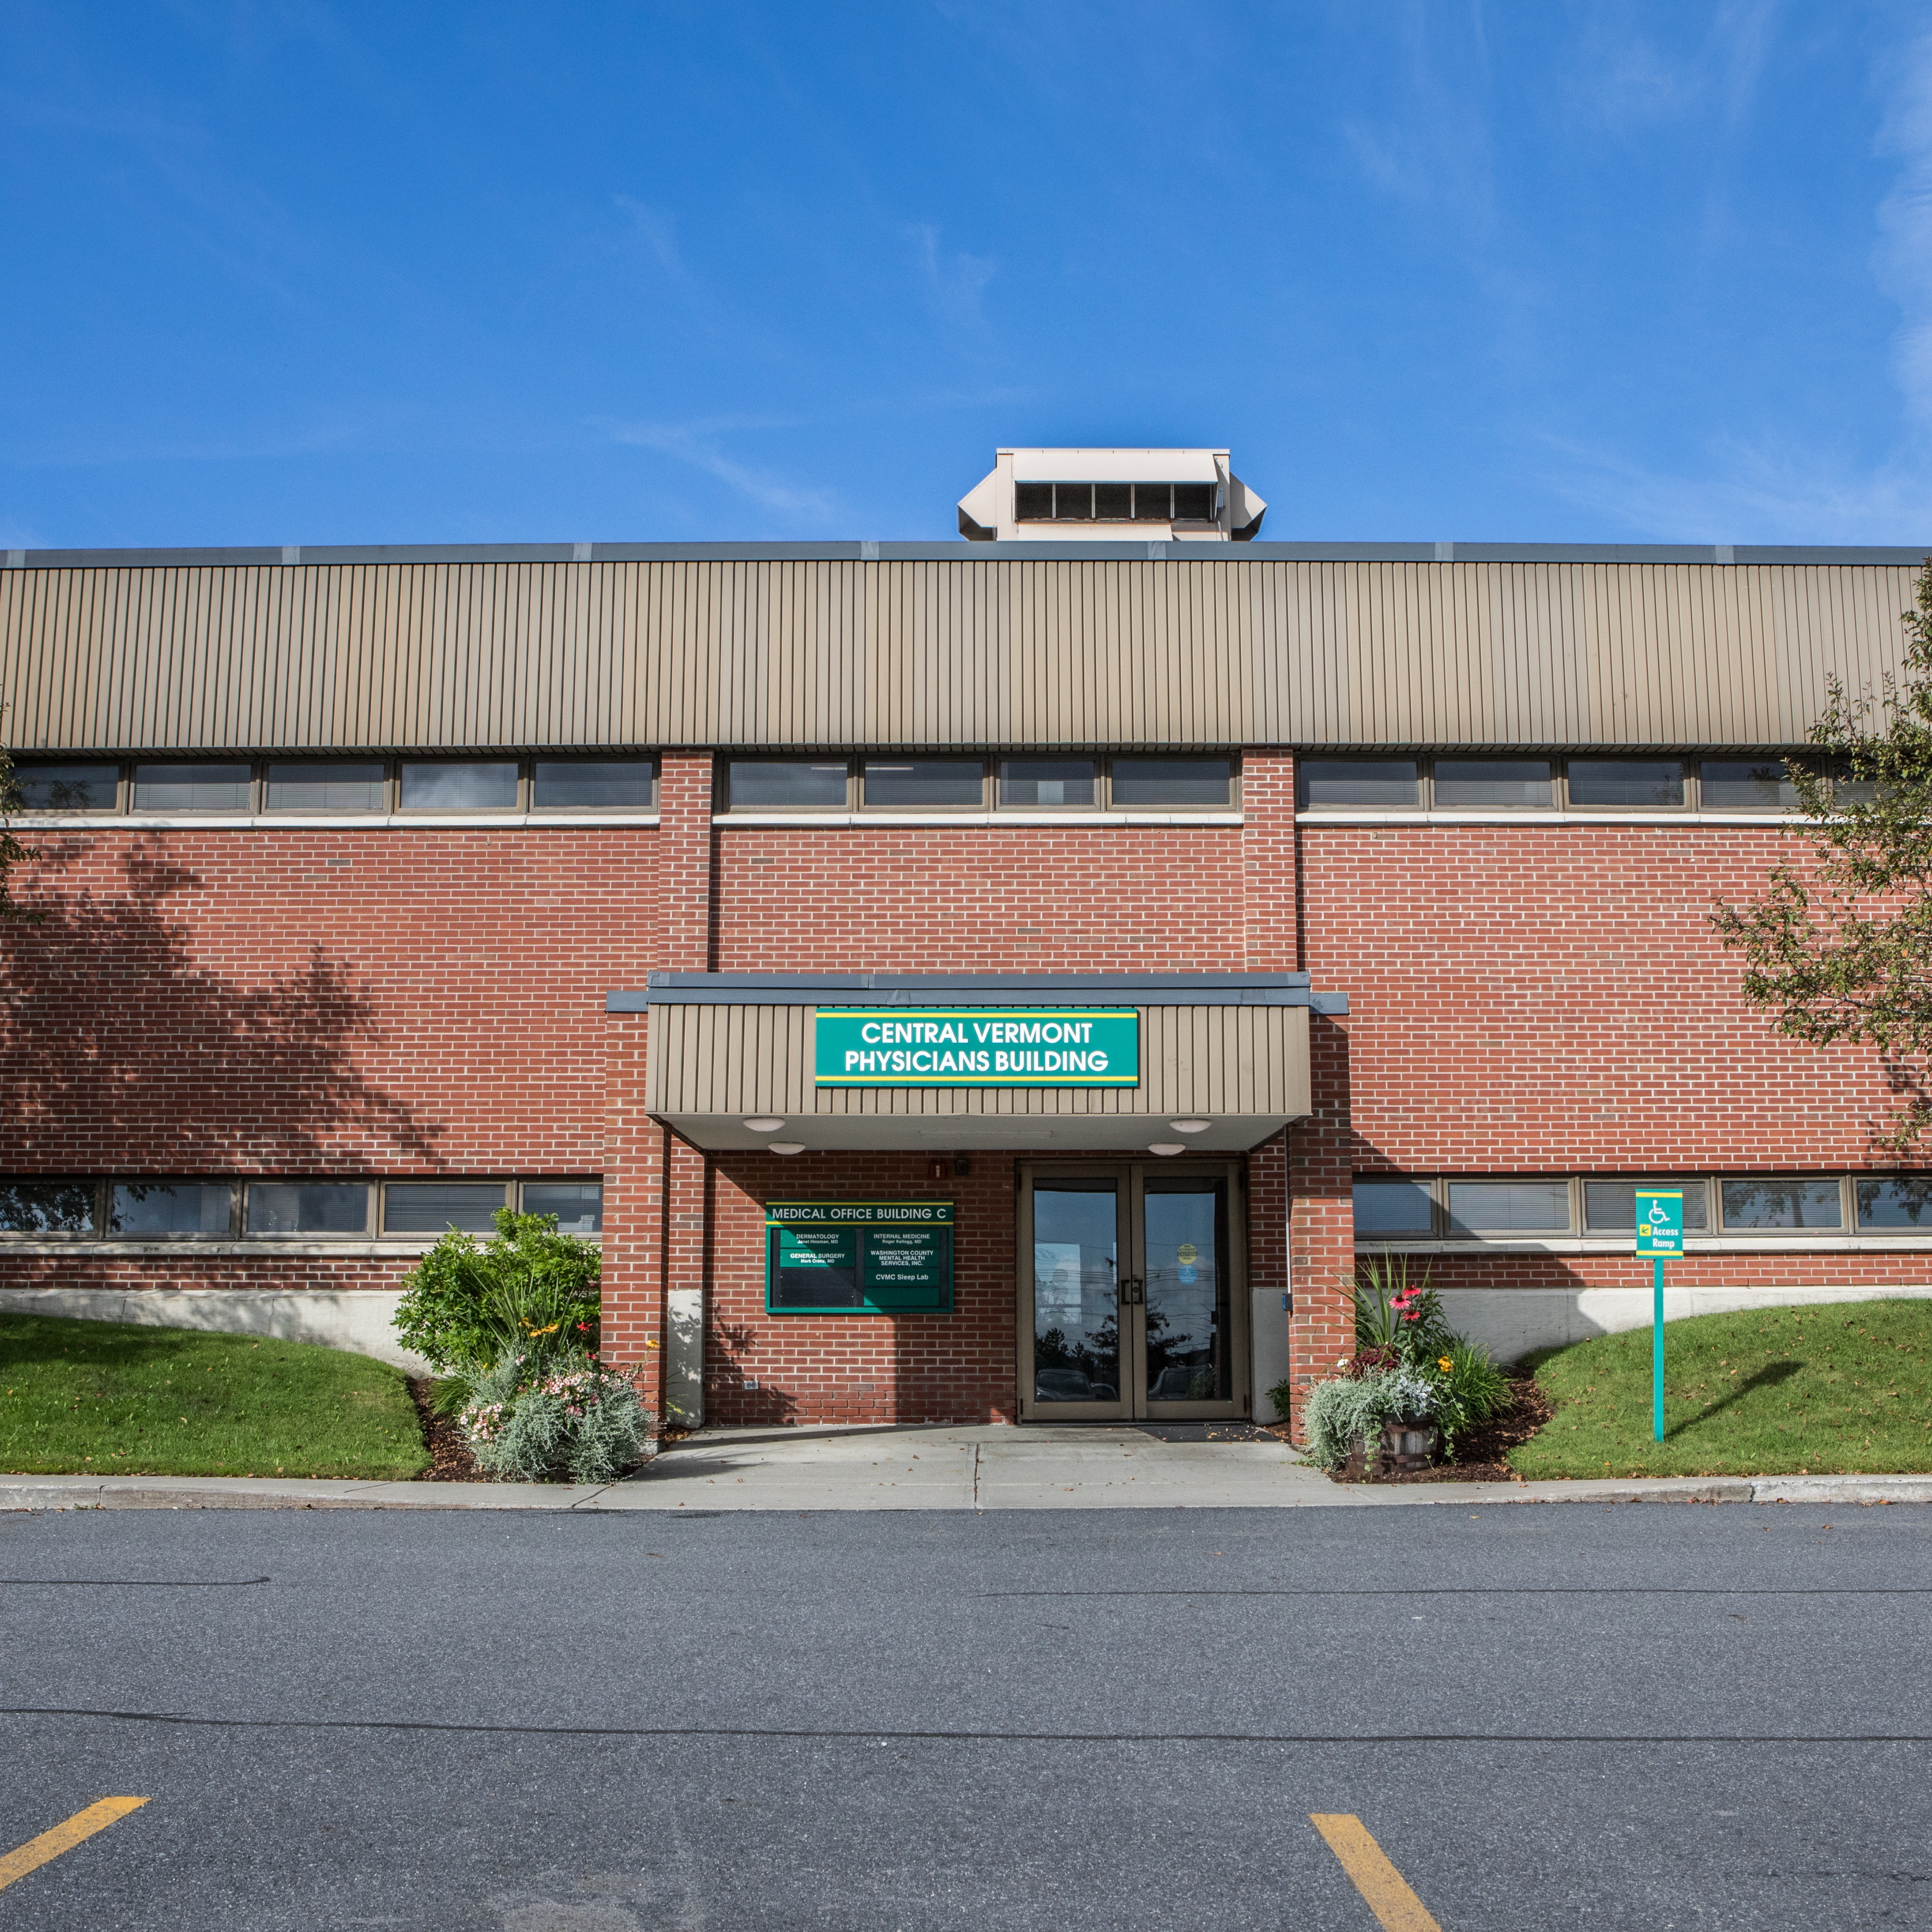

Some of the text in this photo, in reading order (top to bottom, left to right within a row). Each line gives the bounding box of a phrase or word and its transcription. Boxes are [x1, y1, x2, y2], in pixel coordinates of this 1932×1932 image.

[862, 1023, 1092, 1044] CENTRAL VERMONT
[846, 1051, 1108, 1071] PHYSICIANS BUILDING
[772, 1209, 946, 1219] MEDICAL OFFICE BUILDING C
[1653, 1227, 1678, 1235] Access
[1653, 1238, 1674, 1249] Ramp
